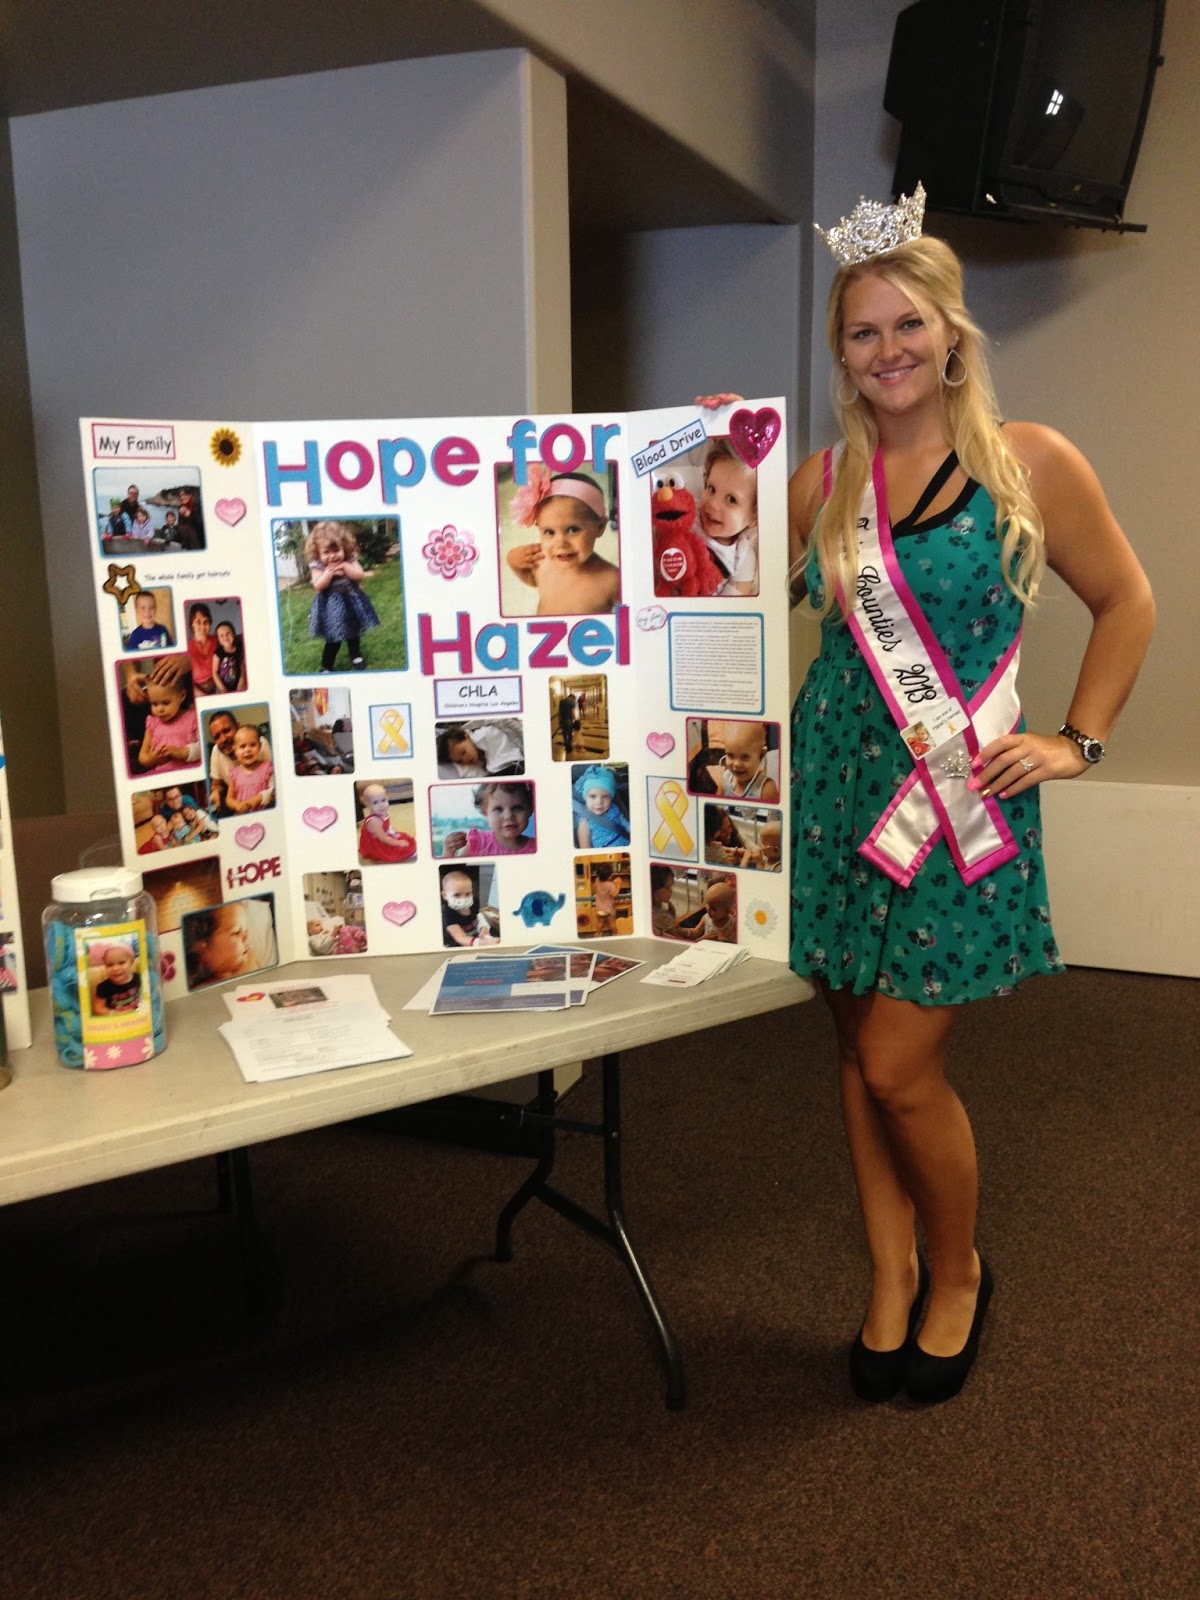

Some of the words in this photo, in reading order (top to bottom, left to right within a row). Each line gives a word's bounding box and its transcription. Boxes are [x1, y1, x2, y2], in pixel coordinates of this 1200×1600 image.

[99, 435, 120, 455] My
[127, 434, 172, 455] Family
[635, 444, 666, 471] Blood
[669, 428, 702, 452] Drive
[263, 436, 480, 507] Hope
[507, 419, 621, 486] for
[144, 573, 156, 581] The
[158, 572, 174, 581] whole
[176, 571, 195, 580] family
[418, 604, 631, 676] Hazel
[856, 565, 902, 653] Counties
[893, 663, 937, 704] 2013
[459, 684, 498, 698] CHLA
[469, 700, 489, 708] Hospital
[500, 699, 519, 707] Angeles
[227, 856, 281, 889] HOPE
